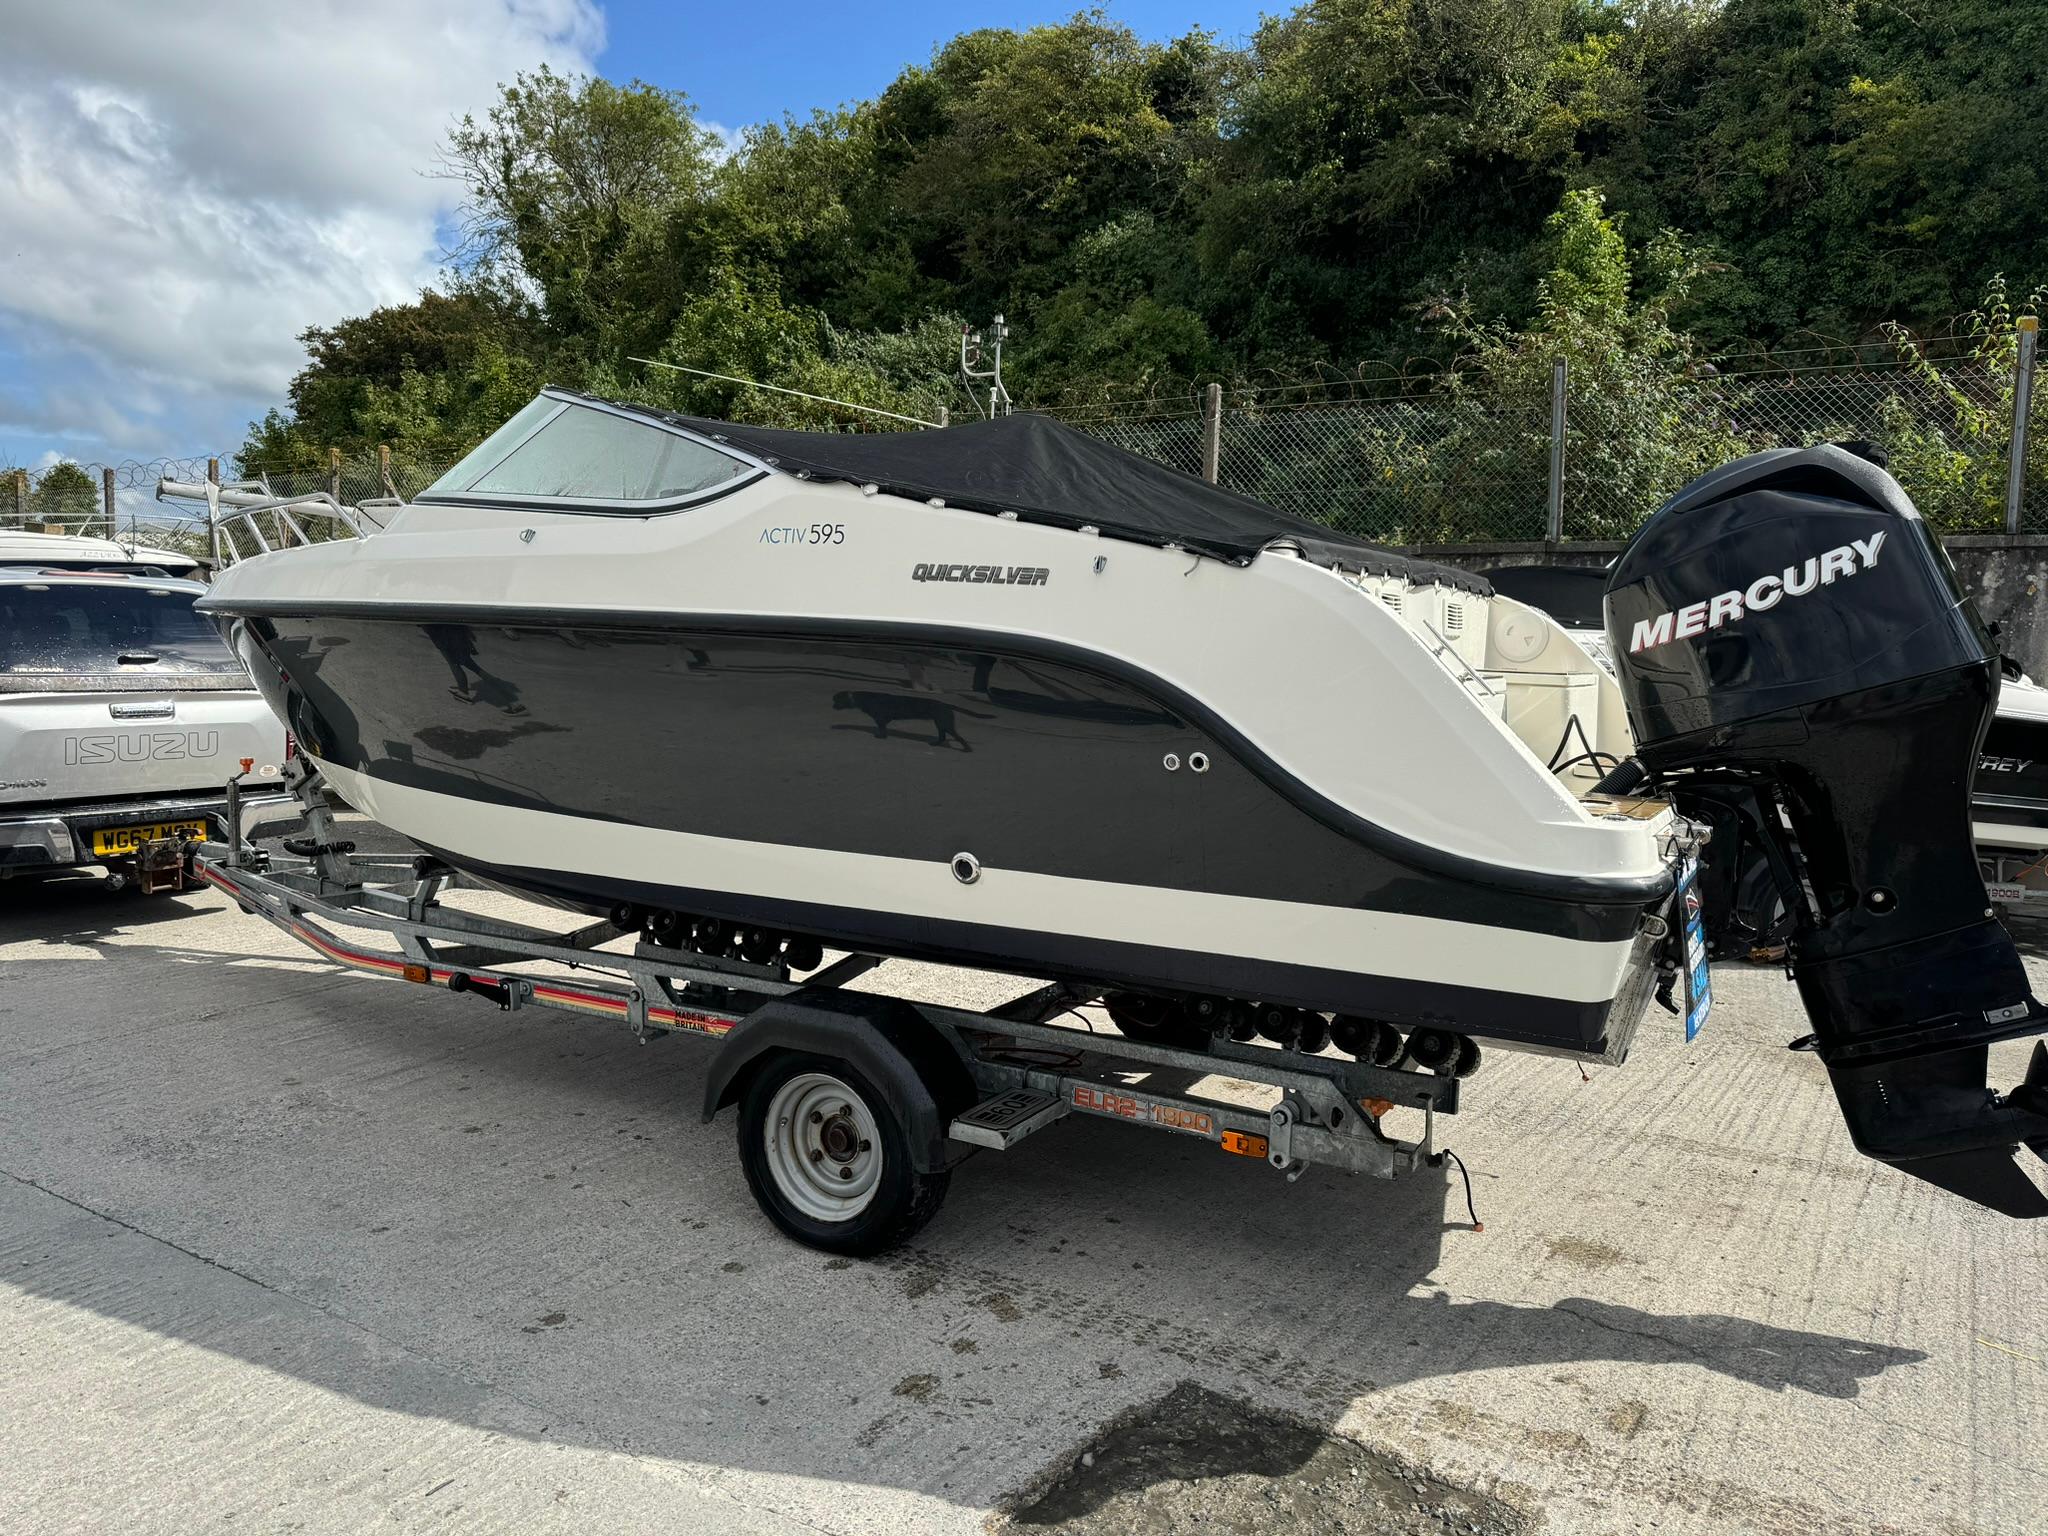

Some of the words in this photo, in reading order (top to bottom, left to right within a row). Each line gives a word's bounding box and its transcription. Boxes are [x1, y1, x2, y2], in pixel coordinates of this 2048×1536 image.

[759, 528, 807, 544] ACTIV
[808, 523, 845, 545] 595
[911, 563, 1050, 587] QUICKSILVER
[1629, 530, 1887, 653] MERCURY
[64, 730, 219, 766] ISUZU
[102, 829, 155, 851] WG67
[675, 1010, 697, 1020] MADE
[675, 1019, 706, 1032] BRITAIN
